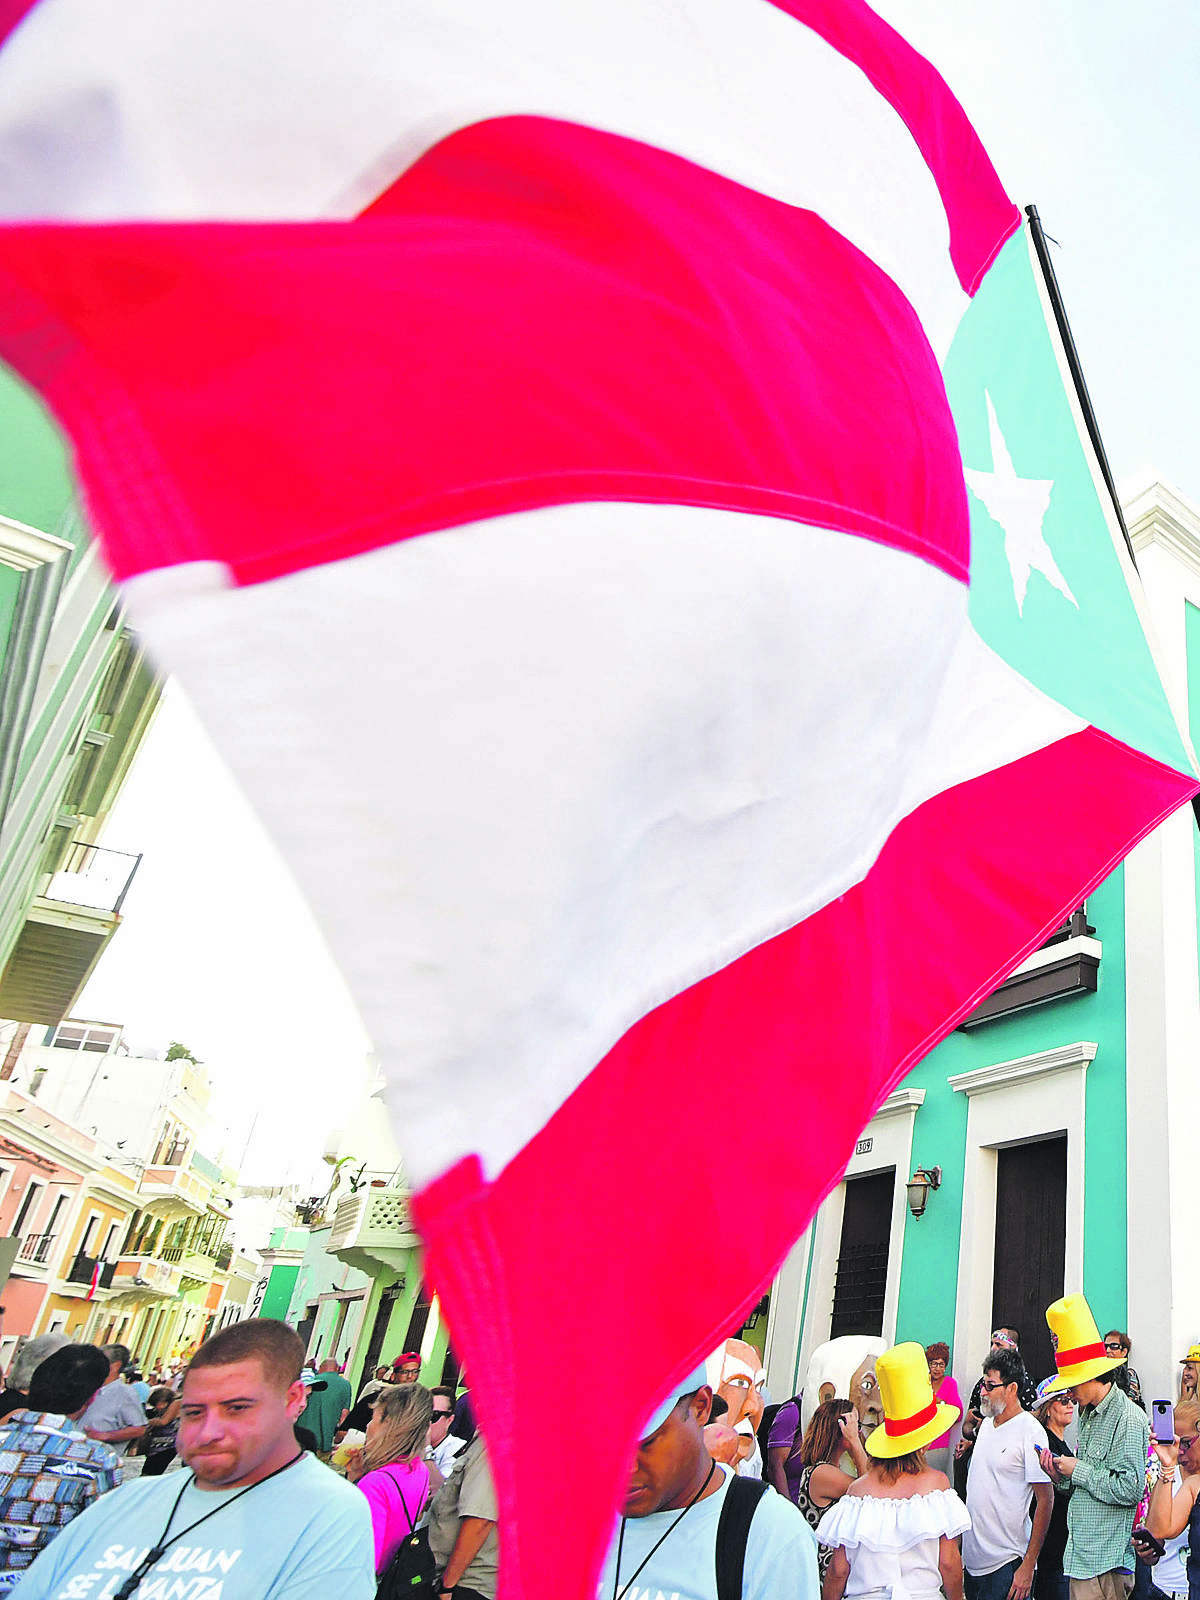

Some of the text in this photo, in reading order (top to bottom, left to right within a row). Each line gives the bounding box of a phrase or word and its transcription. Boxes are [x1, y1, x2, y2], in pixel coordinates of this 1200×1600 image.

[858, 1141, 871, 1152] 309
[156, 1546, 242, 1574] JUAN
[58, 1573, 225, 1600] SE LVANTA
